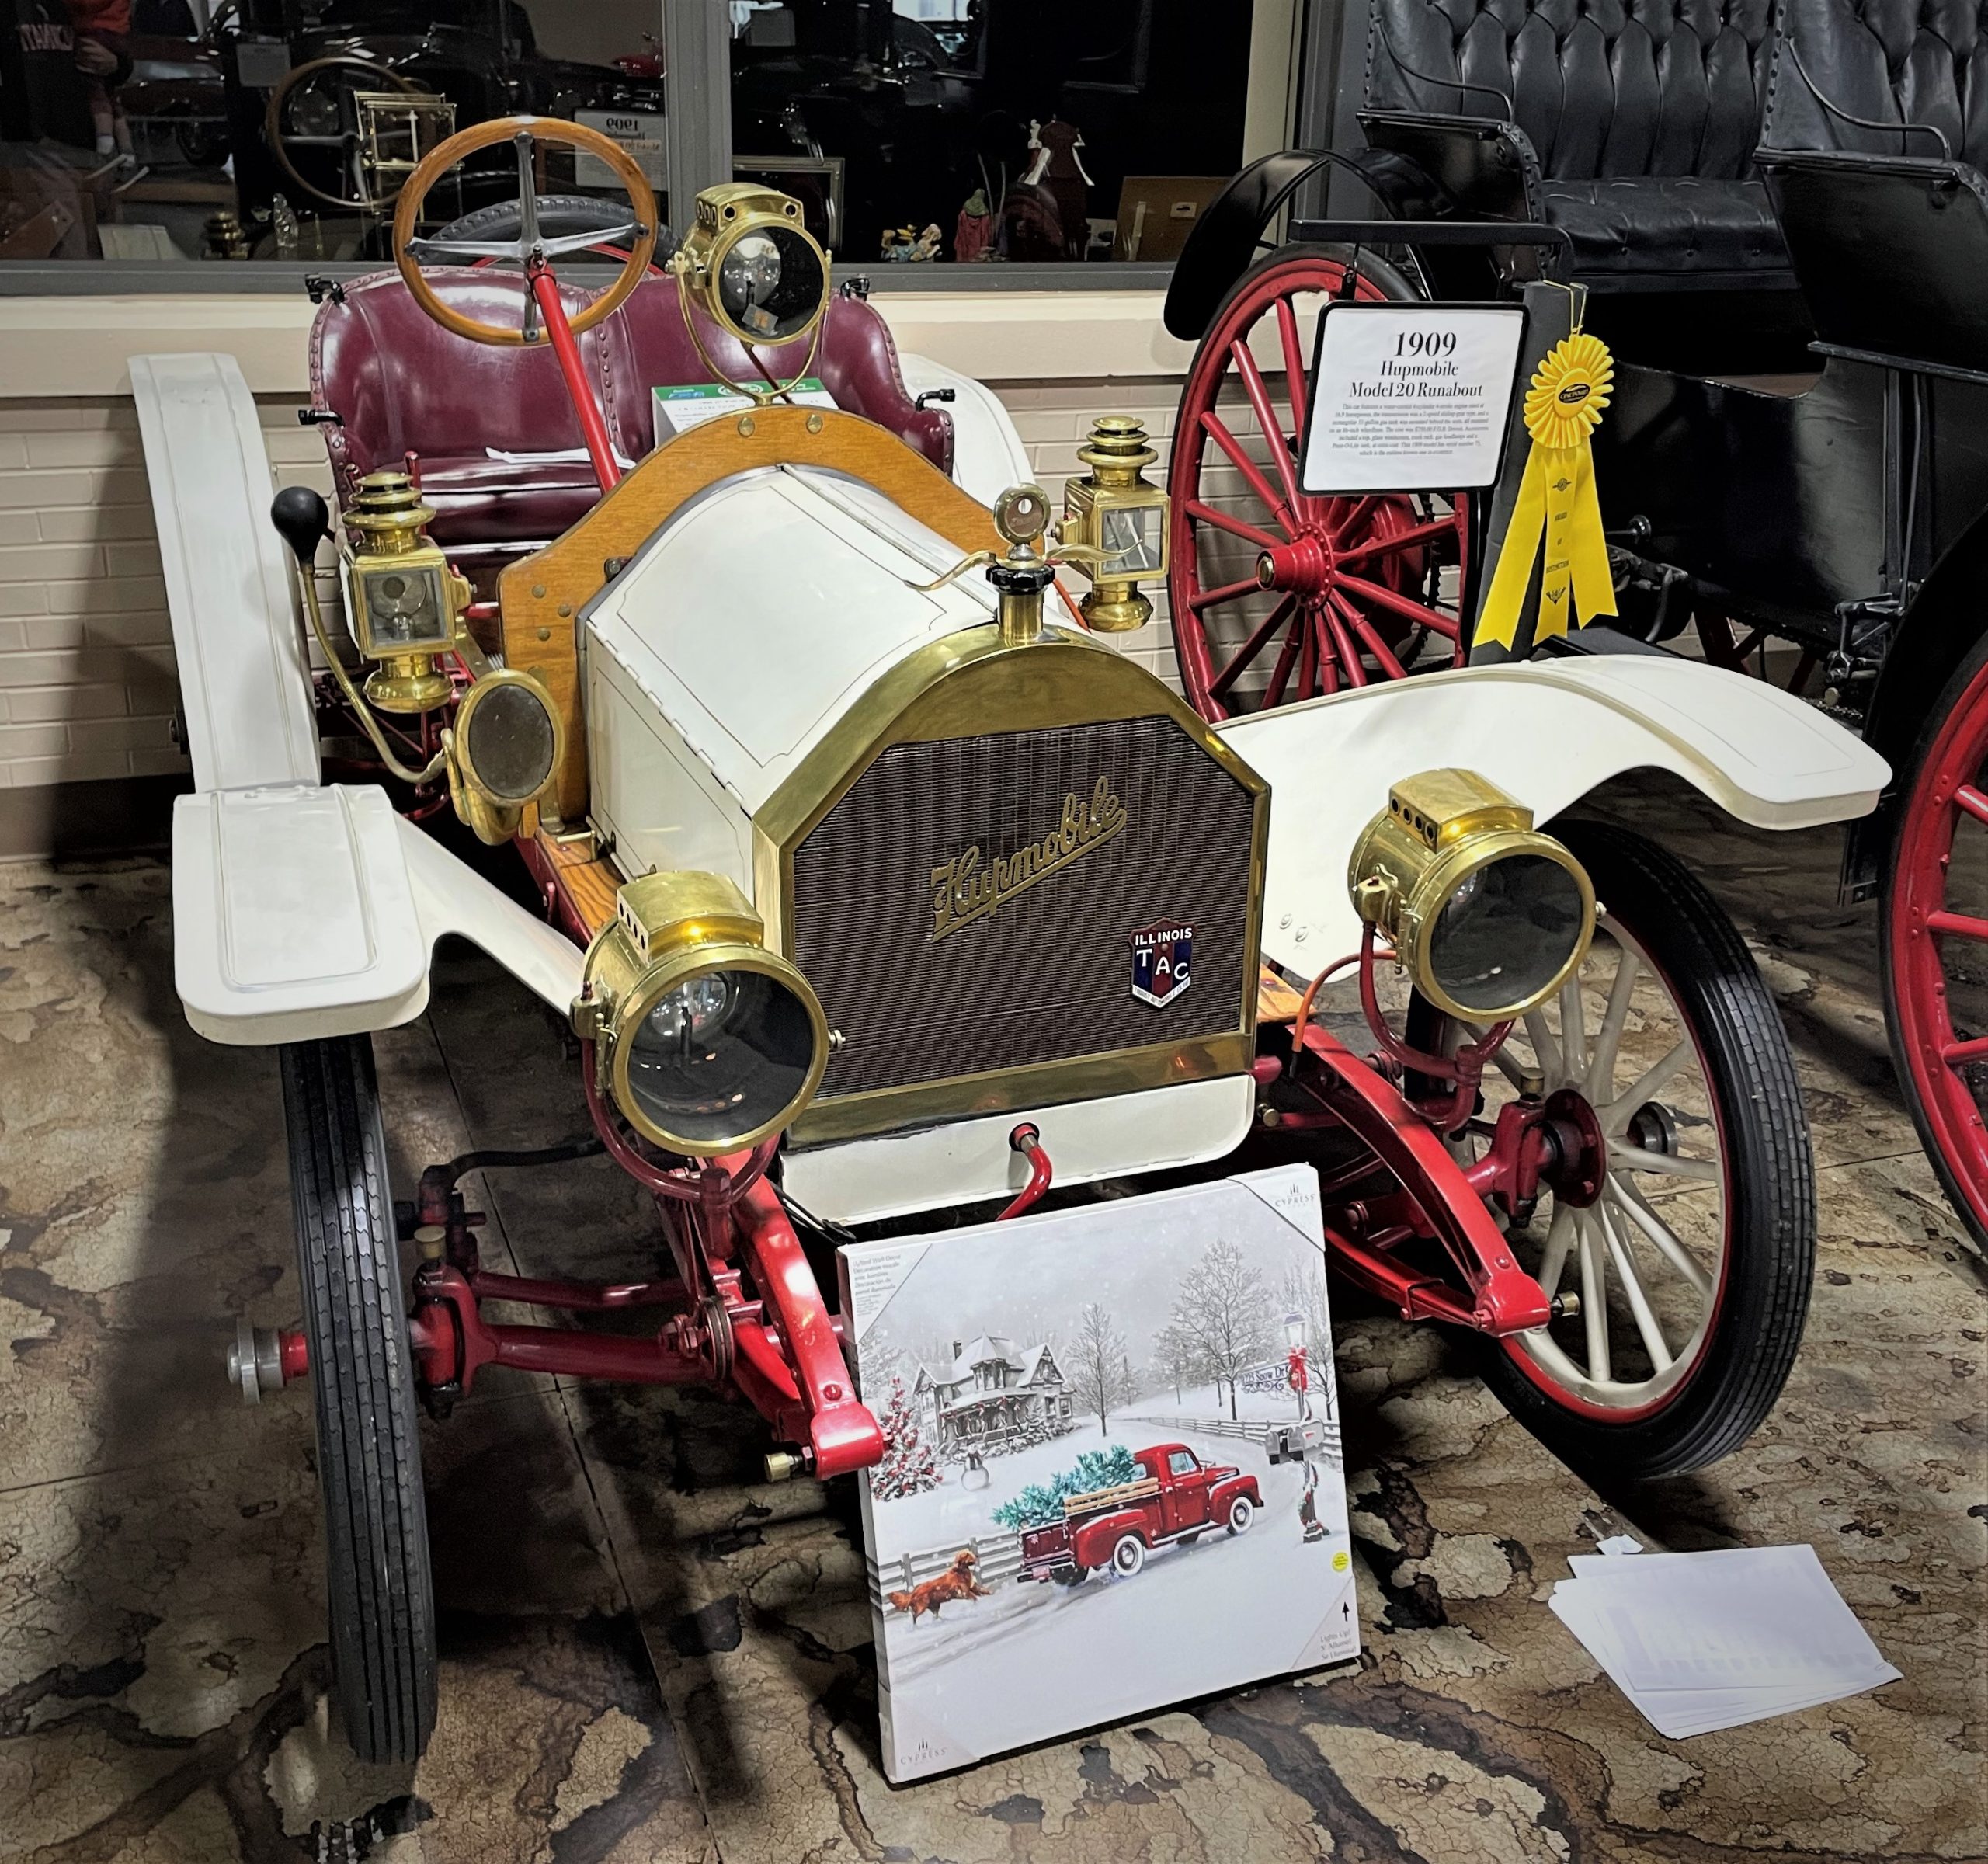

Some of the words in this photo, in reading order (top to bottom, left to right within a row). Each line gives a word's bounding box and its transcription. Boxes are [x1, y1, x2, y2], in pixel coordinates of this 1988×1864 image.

[1394, 332, 1457, 357] 1909
[1381, 360, 1458, 381] Hupmobile
[1350, 382, 1393, 397] Model
[1395, 382, 1415, 397] 20
[1417, 382, 1482, 397] Runabout
[931, 777, 1127, 937] Hupmobile
[1135, 927, 1193, 946] ILLINOIS
[1275, 1194, 1315, 1207] CYPRESS
[901, 1747, 947, 1765] CYPRESS
